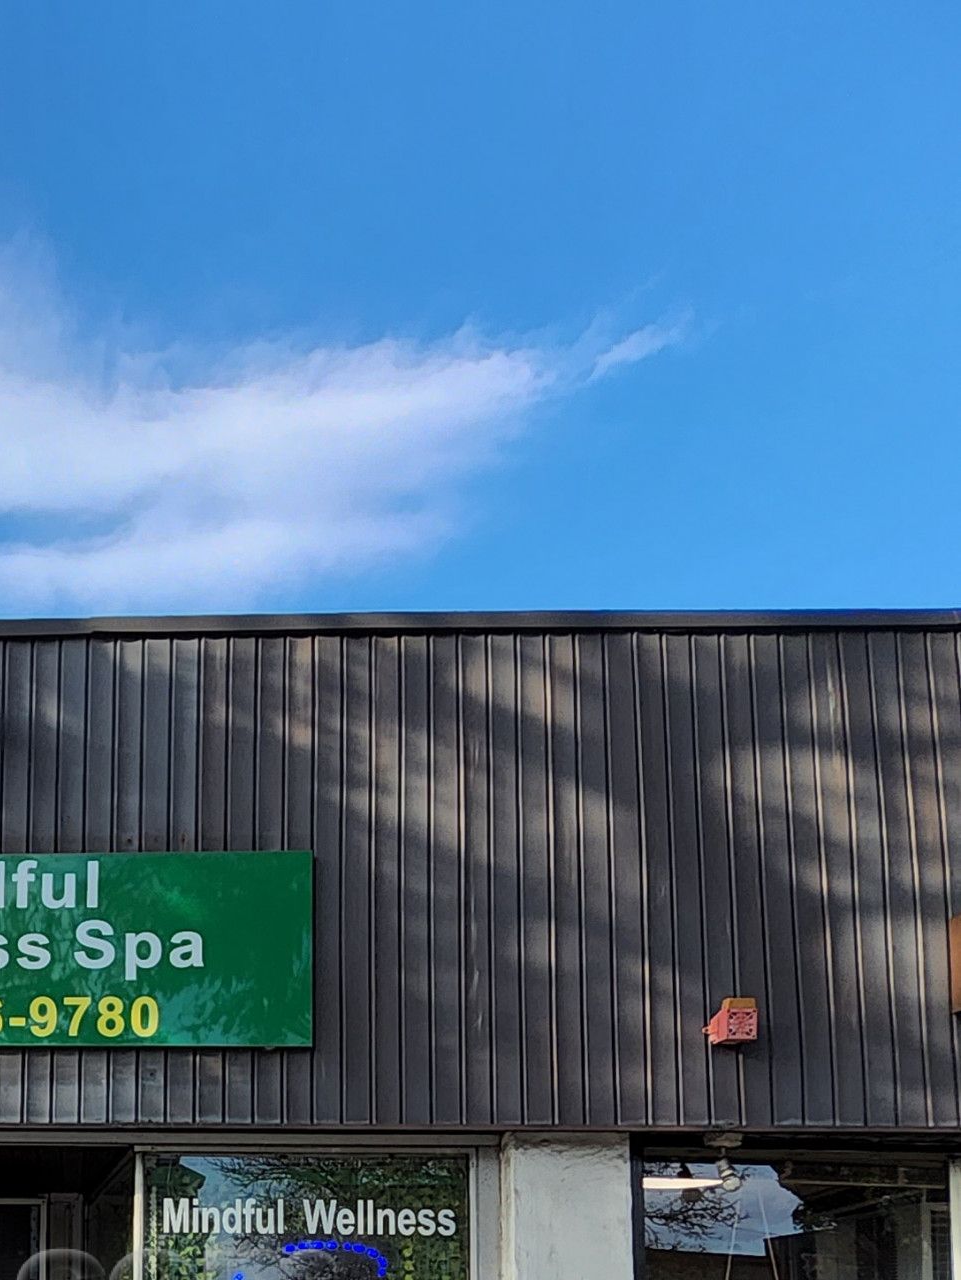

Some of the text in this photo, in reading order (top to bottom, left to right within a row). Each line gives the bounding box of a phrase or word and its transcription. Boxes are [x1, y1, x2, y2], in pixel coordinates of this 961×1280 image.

[73, 918, 205, 982] Spa
[162, 1197, 457, 1237] Mindful Wellness
